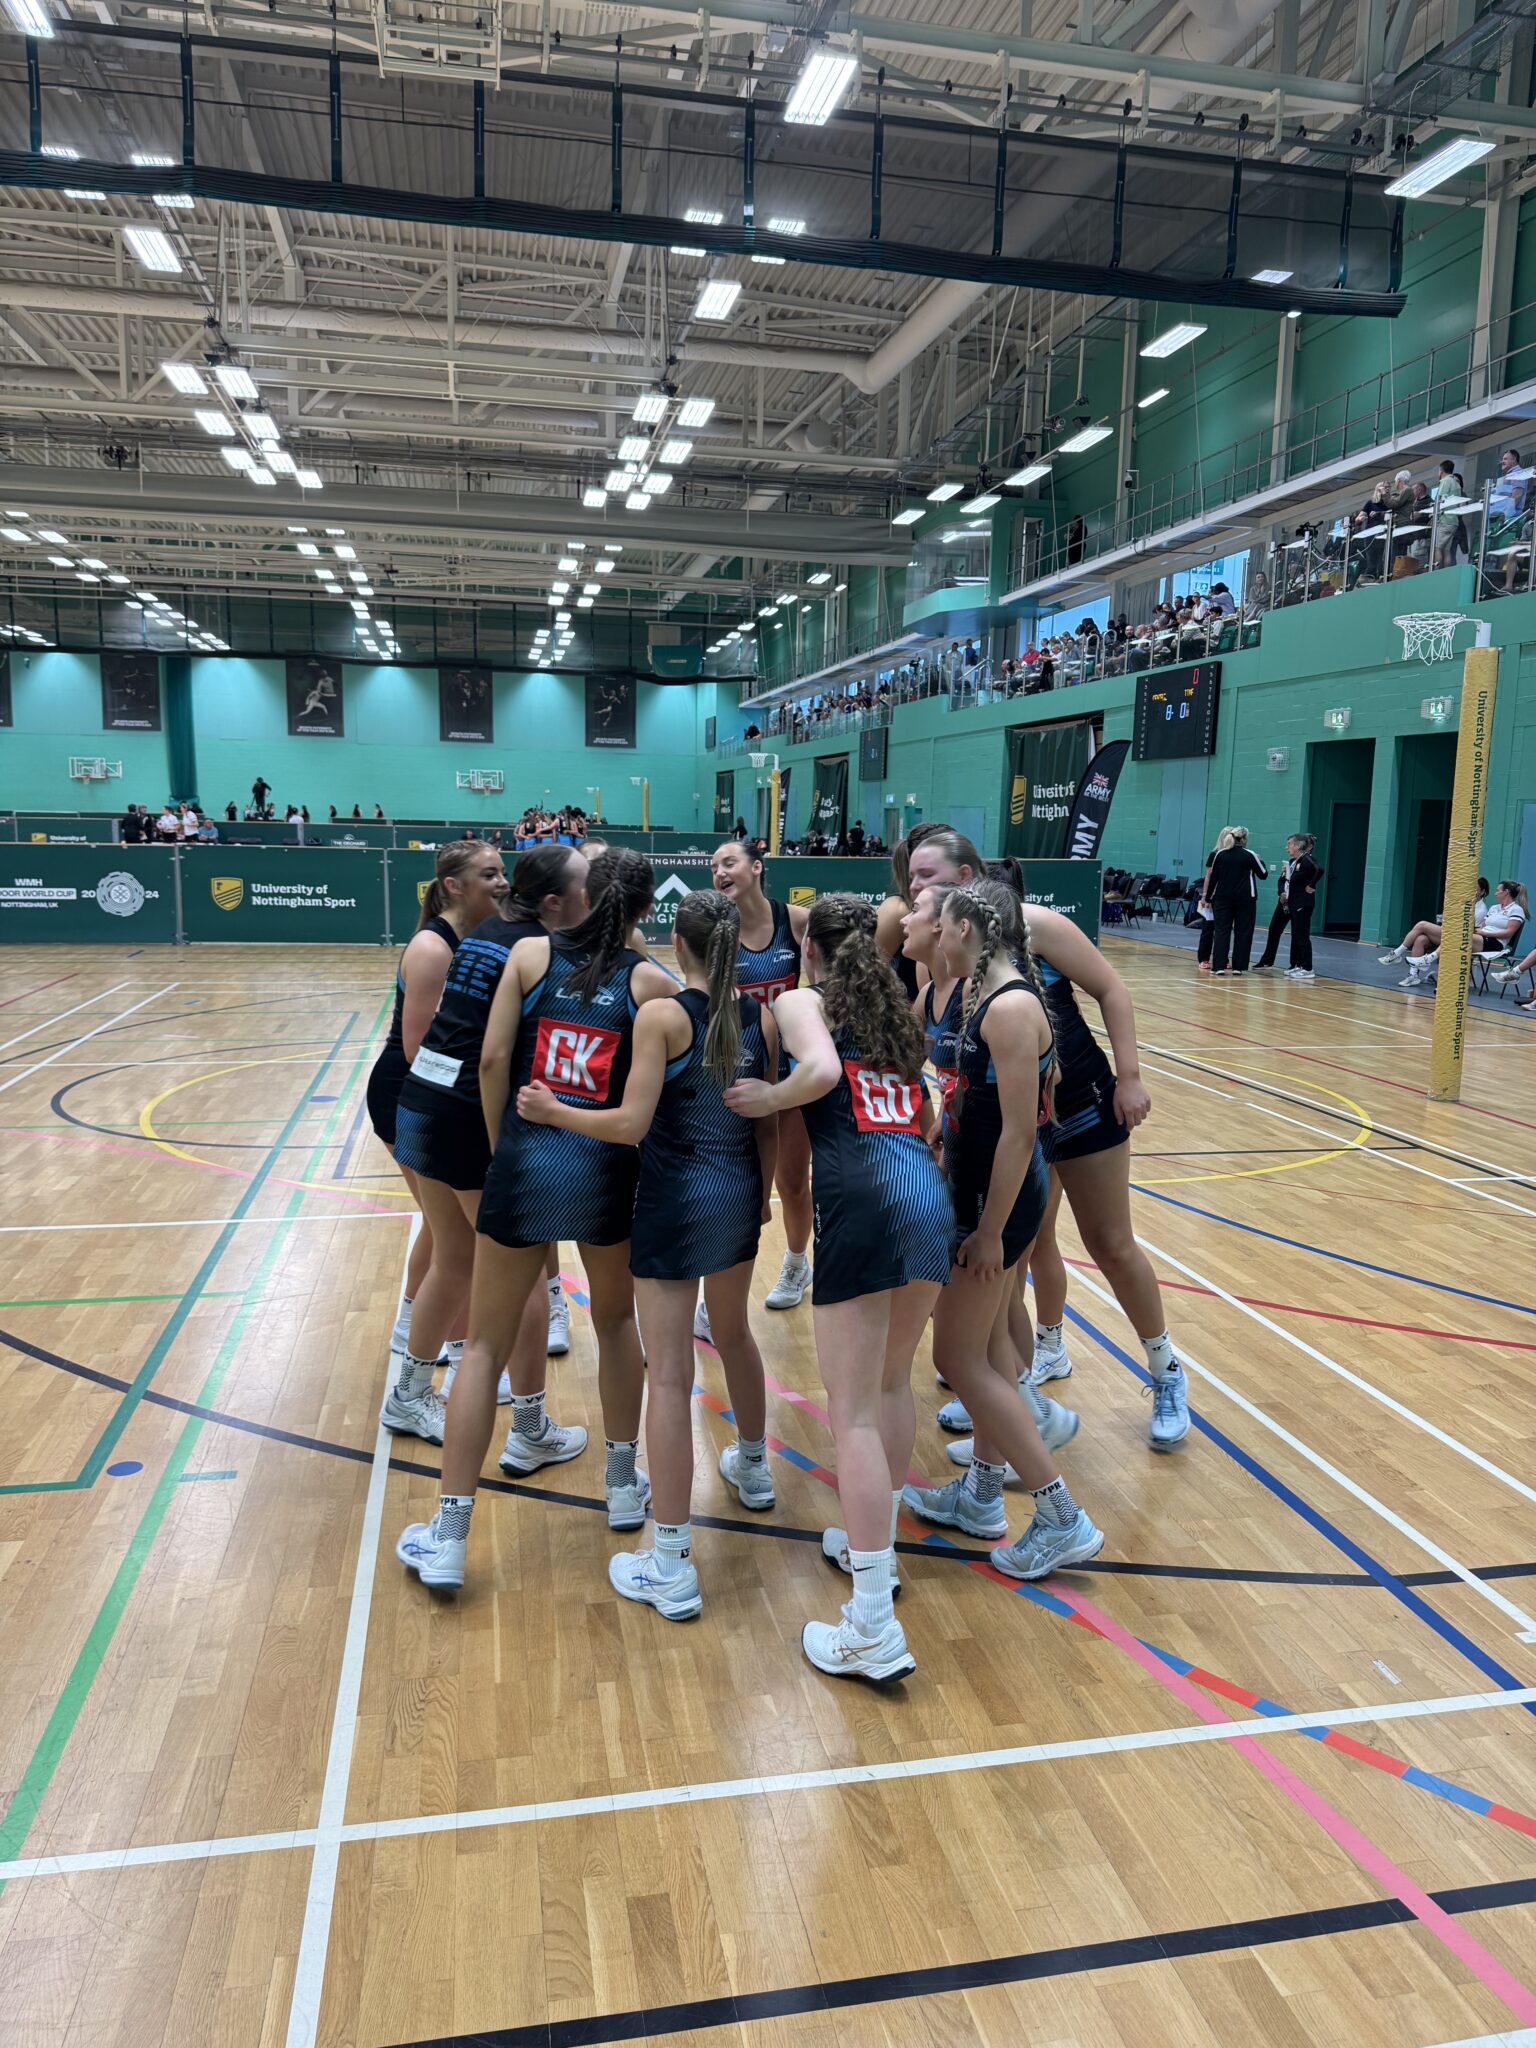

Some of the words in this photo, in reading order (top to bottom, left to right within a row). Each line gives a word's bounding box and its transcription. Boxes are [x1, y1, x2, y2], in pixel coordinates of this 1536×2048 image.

[1473, 690, 1488, 749] University
[1474, 753, 1483, 762] of
[1084, 783, 1111, 798] ARMY
[14, 878, 43, 886] WMH
[0, 889, 20, 897] OOR
[22, 889, 54, 897] WORLD
[56, 889, 74, 897] CUP
[81, 890, 96, 898] 20
[145, 890, 159, 898] 24
[251, 883, 313, 896] University
[315, 884, 328, 894] of
[252, 896, 322, 908] Nottingham
[324, 897, 356, 908] Sport
[1050, 904, 1076, 914] Sport
[1460, 900, 1472, 953] University
[1460, 955, 1468, 964] of
[1455, 968, 1468, 1030] Nottingham
[1453, 1031, 1464, 1060] Sport
[545, 1029, 603, 1091] GK
[1030, 1481, 1062, 1498] VYPR
[657, 1526, 678, 1534] VYPR
